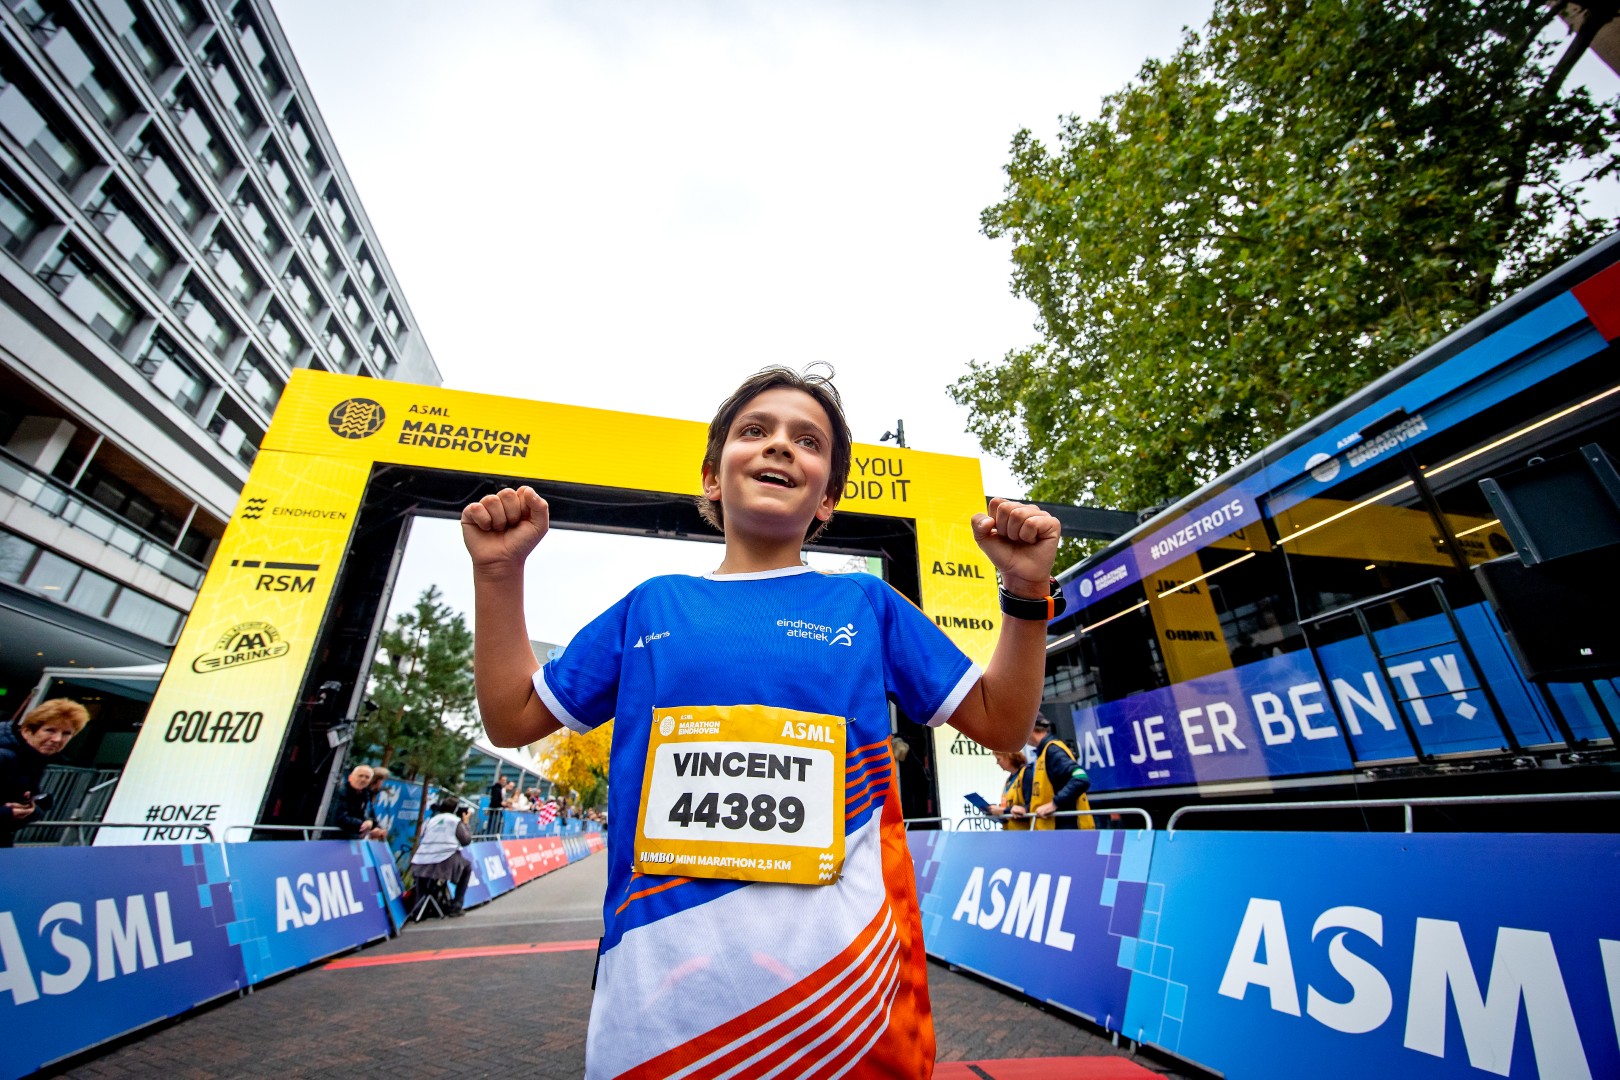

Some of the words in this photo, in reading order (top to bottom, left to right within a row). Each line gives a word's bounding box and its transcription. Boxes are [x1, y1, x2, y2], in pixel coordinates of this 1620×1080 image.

[408, 404, 450, 417] ASML
[401, 419, 531, 445] MARATHON
[398, 432, 528, 458] EINDHOVEN
[1348, 422, 1429, 468] EINDHOVEN
[855, 458, 904, 477] YOU
[843, 480, 883, 500] DID
[891, 480, 911, 502] IT
[272, 506, 348, 520] EINDHOVEN
[1150, 499, 1244, 560] #ONZETROTS
[931, 561, 985, 579] ASML
[255, 574, 317, 593] RSM
[776, 618, 832, 634] eindhoven
[786, 629, 829, 643] atletiek
[232, 633, 267, 653] AA
[224, 647, 272, 665] DRINK
[1077, 726, 1115, 770] AT
[1130, 715, 1173, 764] JE
[1179, 701, 1247, 756] ER
[1251, 653, 1478, 746] BENT!
[164, 710, 264, 743] GOLAZO
[678, 728, 720, 736] EINDHOVEN
[679, 721, 721, 729] MARATHON
[781, 720, 836, 744] ASML
[673, 752, 813, 783] VINCENT
[145, 804, 221, 822] #ONZE
[668, 792, 806, 834] 44389
[639, 851, 676, 864] JUMBO
[675, 854, 697, 865] MINI
[697, 856, 757, 868] MARATHON
[757, 859, 773, 870] 2,5
[774, 860, 792, 870] KM
[276, 870, 364, 933] ASML
[952, 866, 1076, 952] ASML
[0, 891, 194, 1006] ASML
